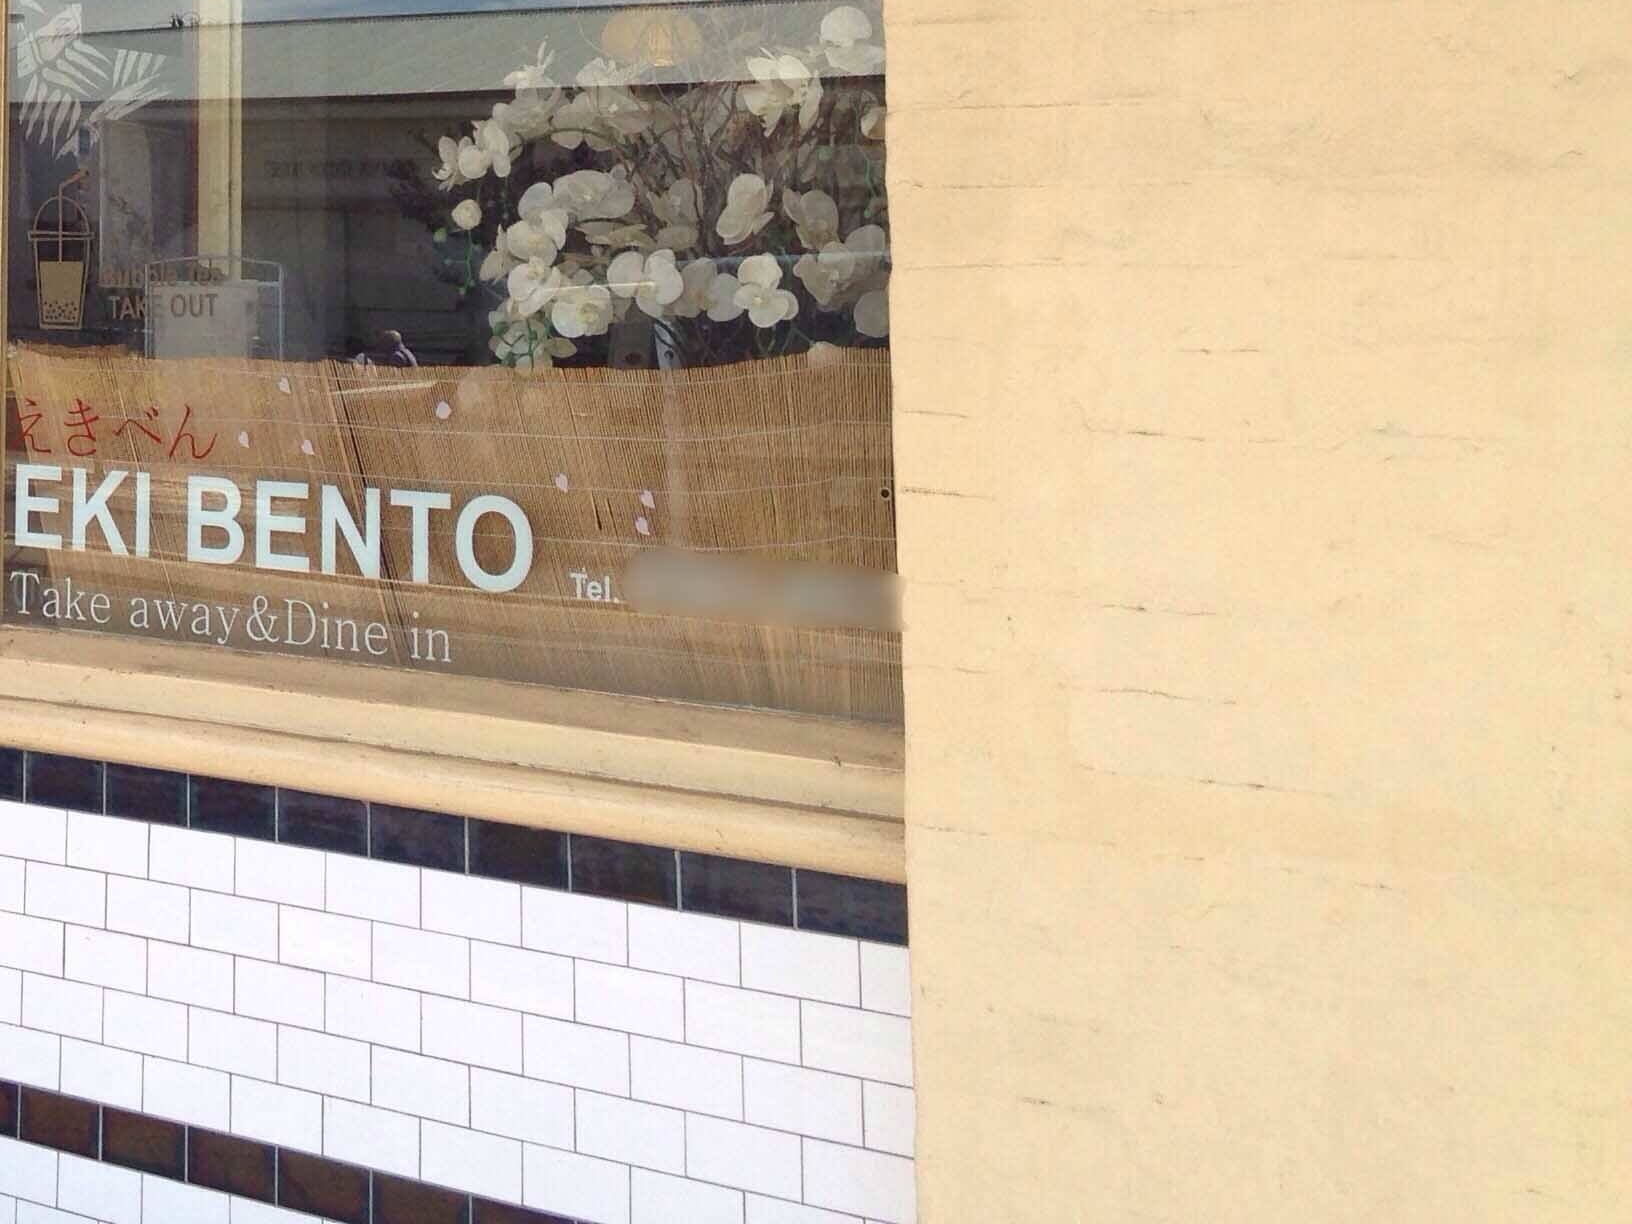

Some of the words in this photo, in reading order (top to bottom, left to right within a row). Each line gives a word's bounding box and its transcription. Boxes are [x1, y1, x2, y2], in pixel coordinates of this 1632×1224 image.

[171, 293, 218, 318] OUT
[13, 397, 218, 460] えきべん
[14, 463, 151, 559] EKI
[186, 474, 534, 594] BENTO
[9, 570, 112, 624] Take
[129, 594, 390, 656] away&Dine
[411, 611, 453, 664] in
[569, 571, 621, 605] Tel.
